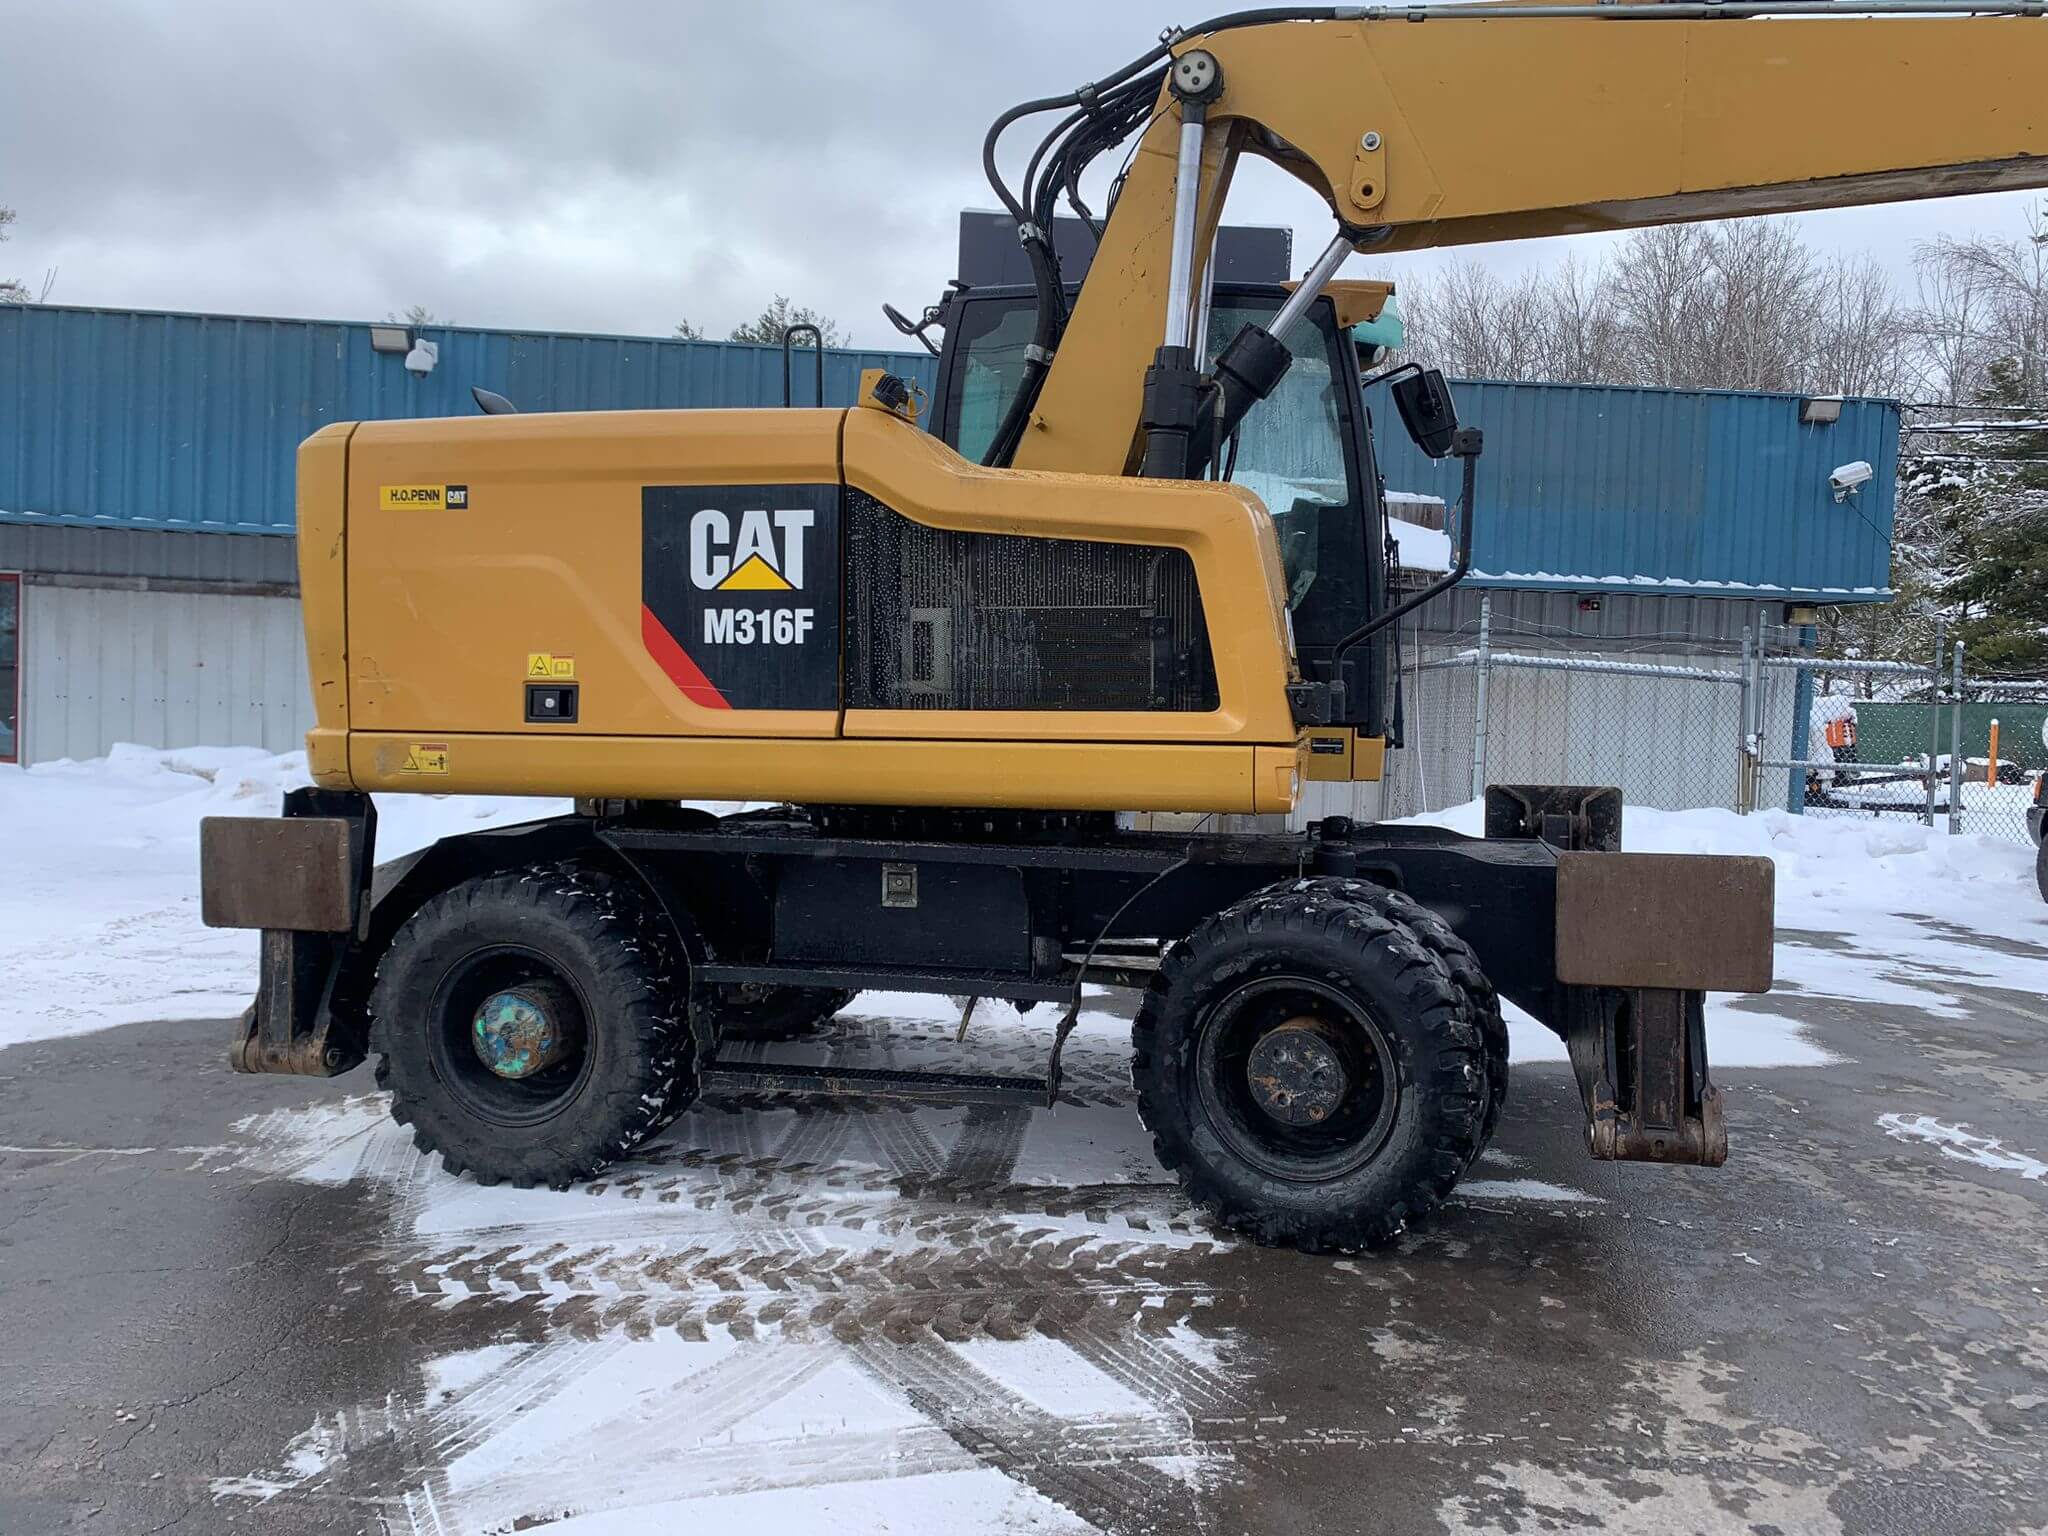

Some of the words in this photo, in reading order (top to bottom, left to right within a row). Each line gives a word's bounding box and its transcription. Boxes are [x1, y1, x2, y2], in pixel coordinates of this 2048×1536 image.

[390, 489, 440, 501] H.O.PENN
[447, 491, 466, 503] CAT
[690, 509, 815, 590] CAT
[703, 608, 814, 645] M316F
